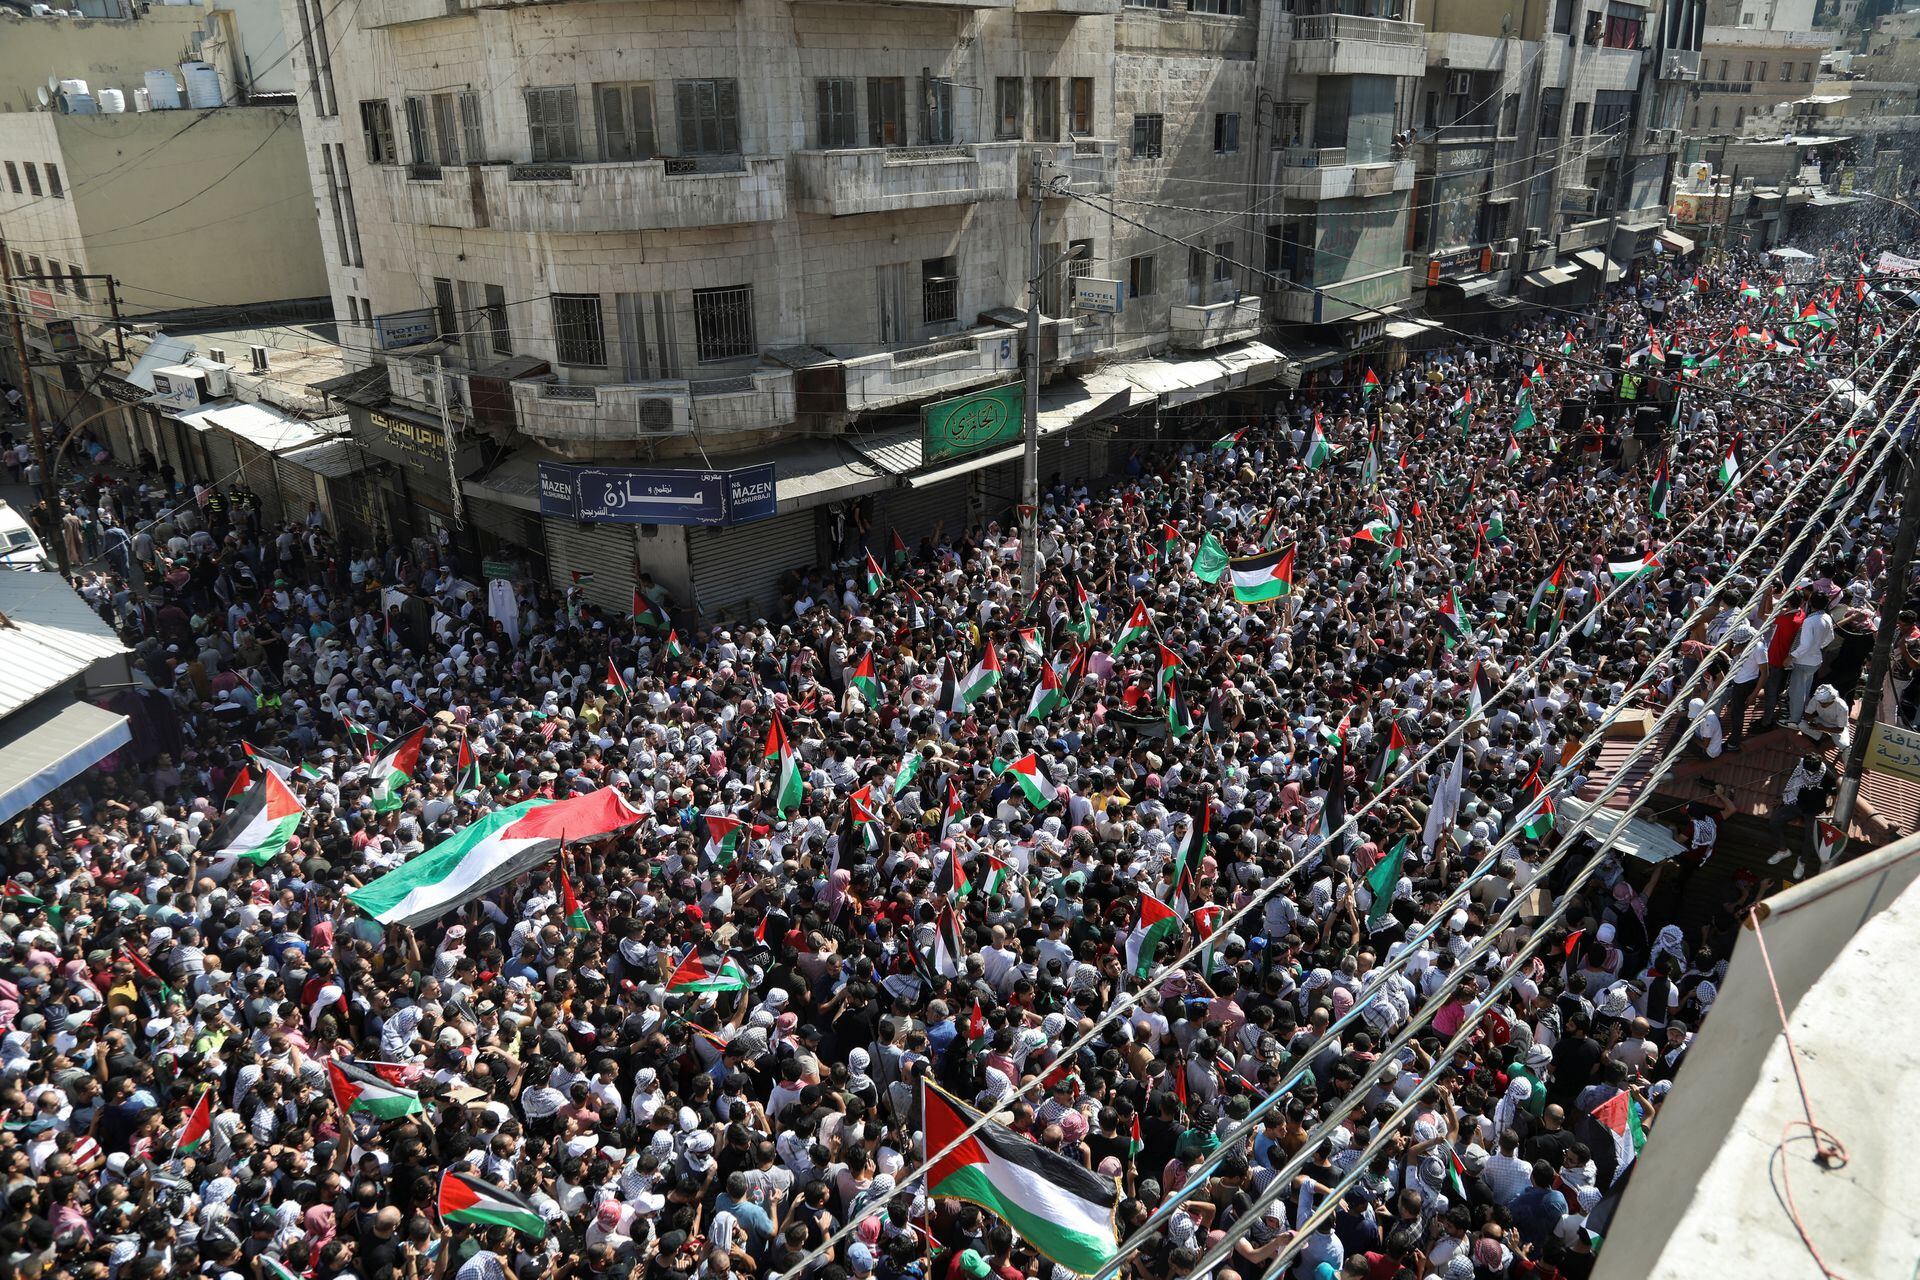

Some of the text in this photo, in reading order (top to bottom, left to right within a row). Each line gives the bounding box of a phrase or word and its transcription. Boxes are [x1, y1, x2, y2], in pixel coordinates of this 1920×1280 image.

[1080, 291, 1115, 300] HOTEL
[386, 324, 431, 336] HOTEL
[1000, 339, 1010, 360] 5
[700, 471, 722, 482] معرض
[541, 479, 572, 495] MAZEN
[603, 479, 703, 508] مازن
[654, 484, 672, 495] نظمي
[732, 481, 772, 499] MAZEN
[734, 492, 771, 506] ALSHURBAJI
